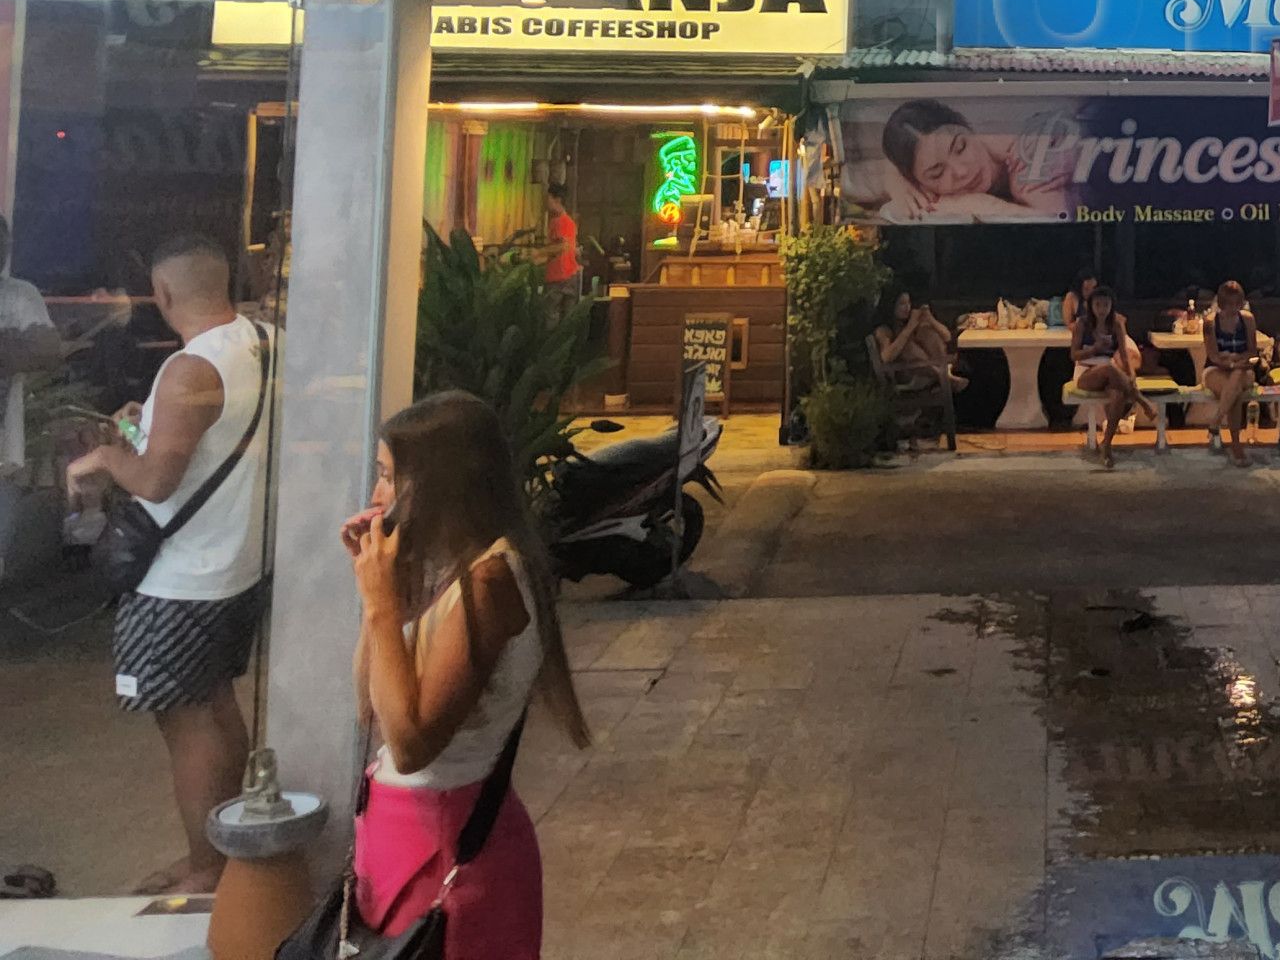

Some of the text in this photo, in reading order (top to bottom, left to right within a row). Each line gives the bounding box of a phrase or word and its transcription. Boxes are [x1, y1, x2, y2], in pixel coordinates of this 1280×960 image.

[521, 16, 721, 41] COFFEESHOP
[1076, 205, 1126, 223] Body
[1134, 204, 1215, 222] Massage
[1240, 203, 1270, 221] Oil
